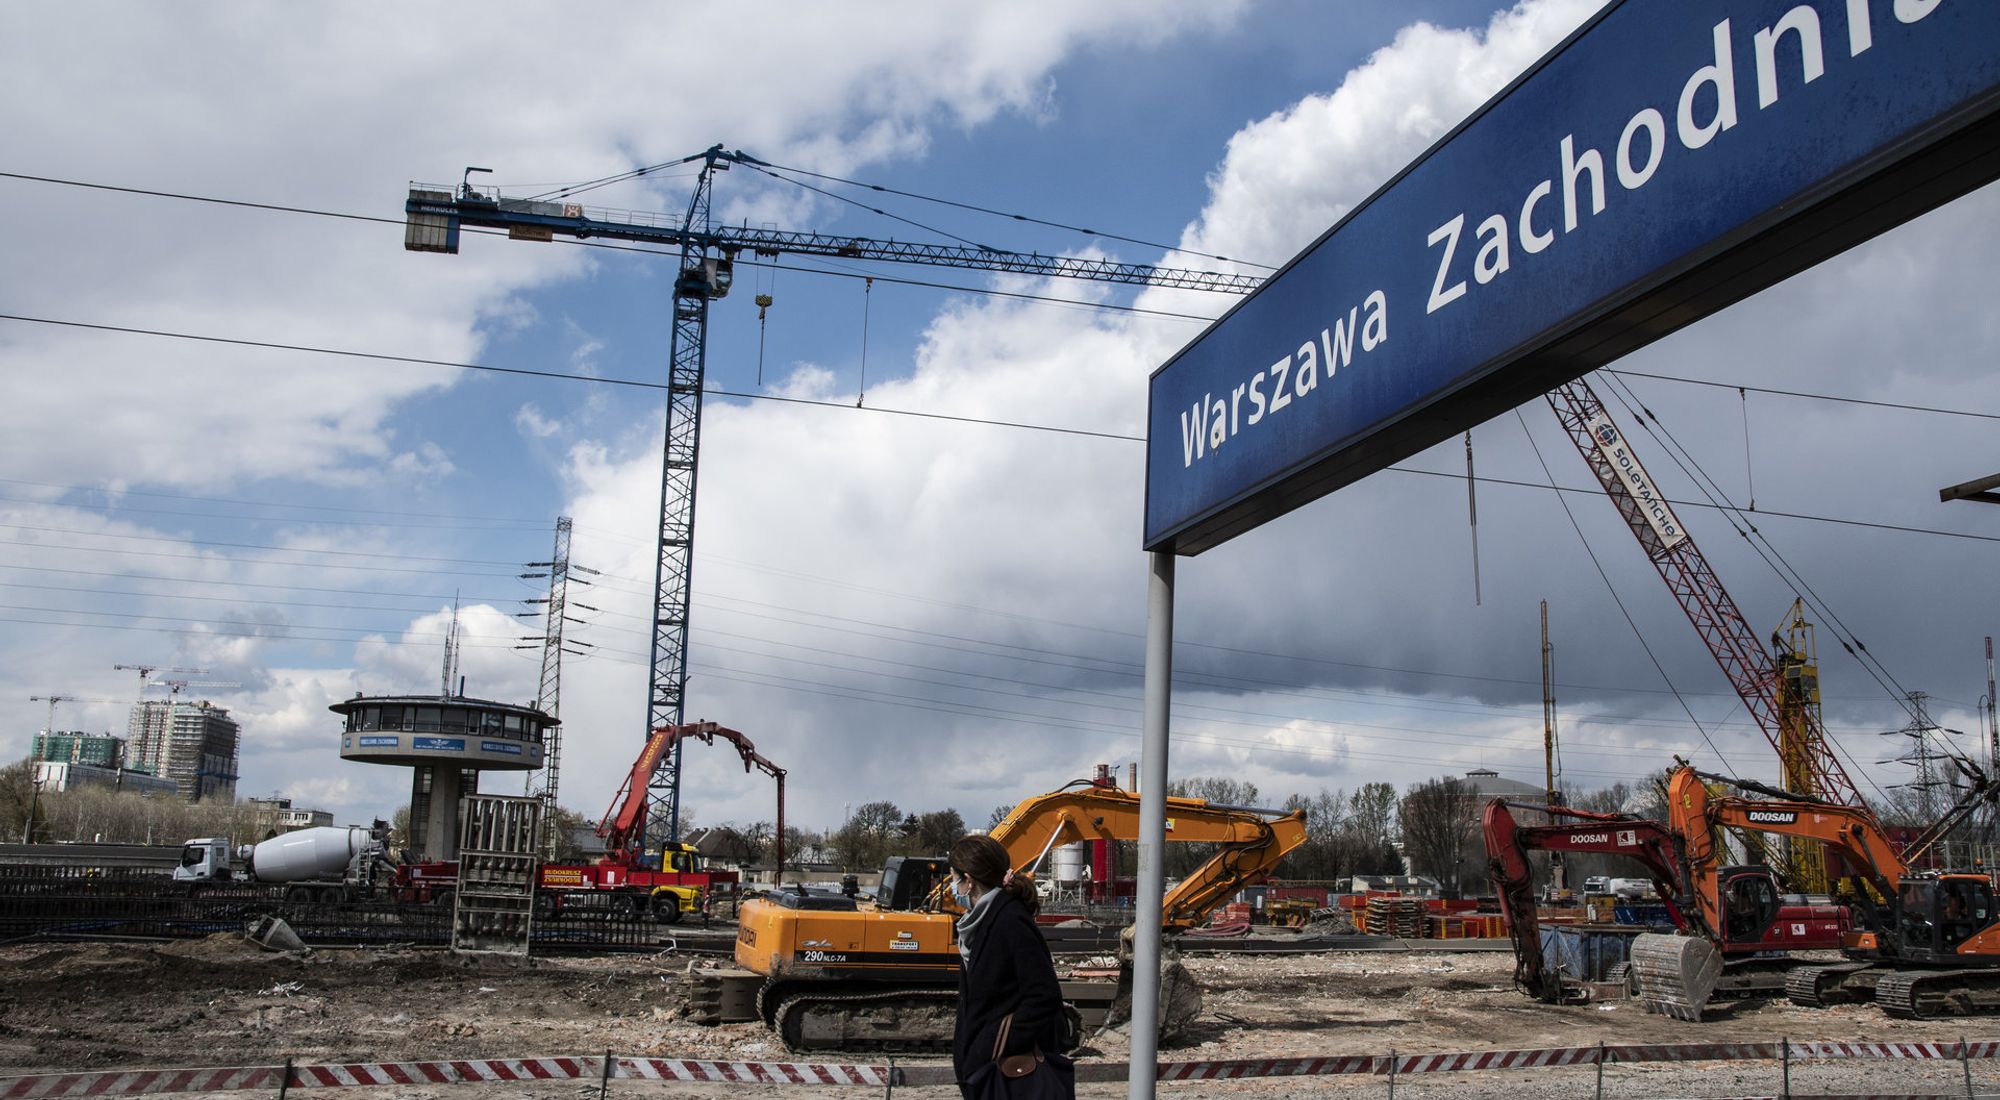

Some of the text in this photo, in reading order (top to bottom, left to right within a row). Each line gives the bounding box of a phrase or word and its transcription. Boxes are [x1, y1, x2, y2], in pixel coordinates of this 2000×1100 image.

[1181, 0, 1943, 468] Warszawa Zachodn
[1750, 811, 1794, 822] DOOSAN
[1570, 833, 1608, 844] DOOSAN
